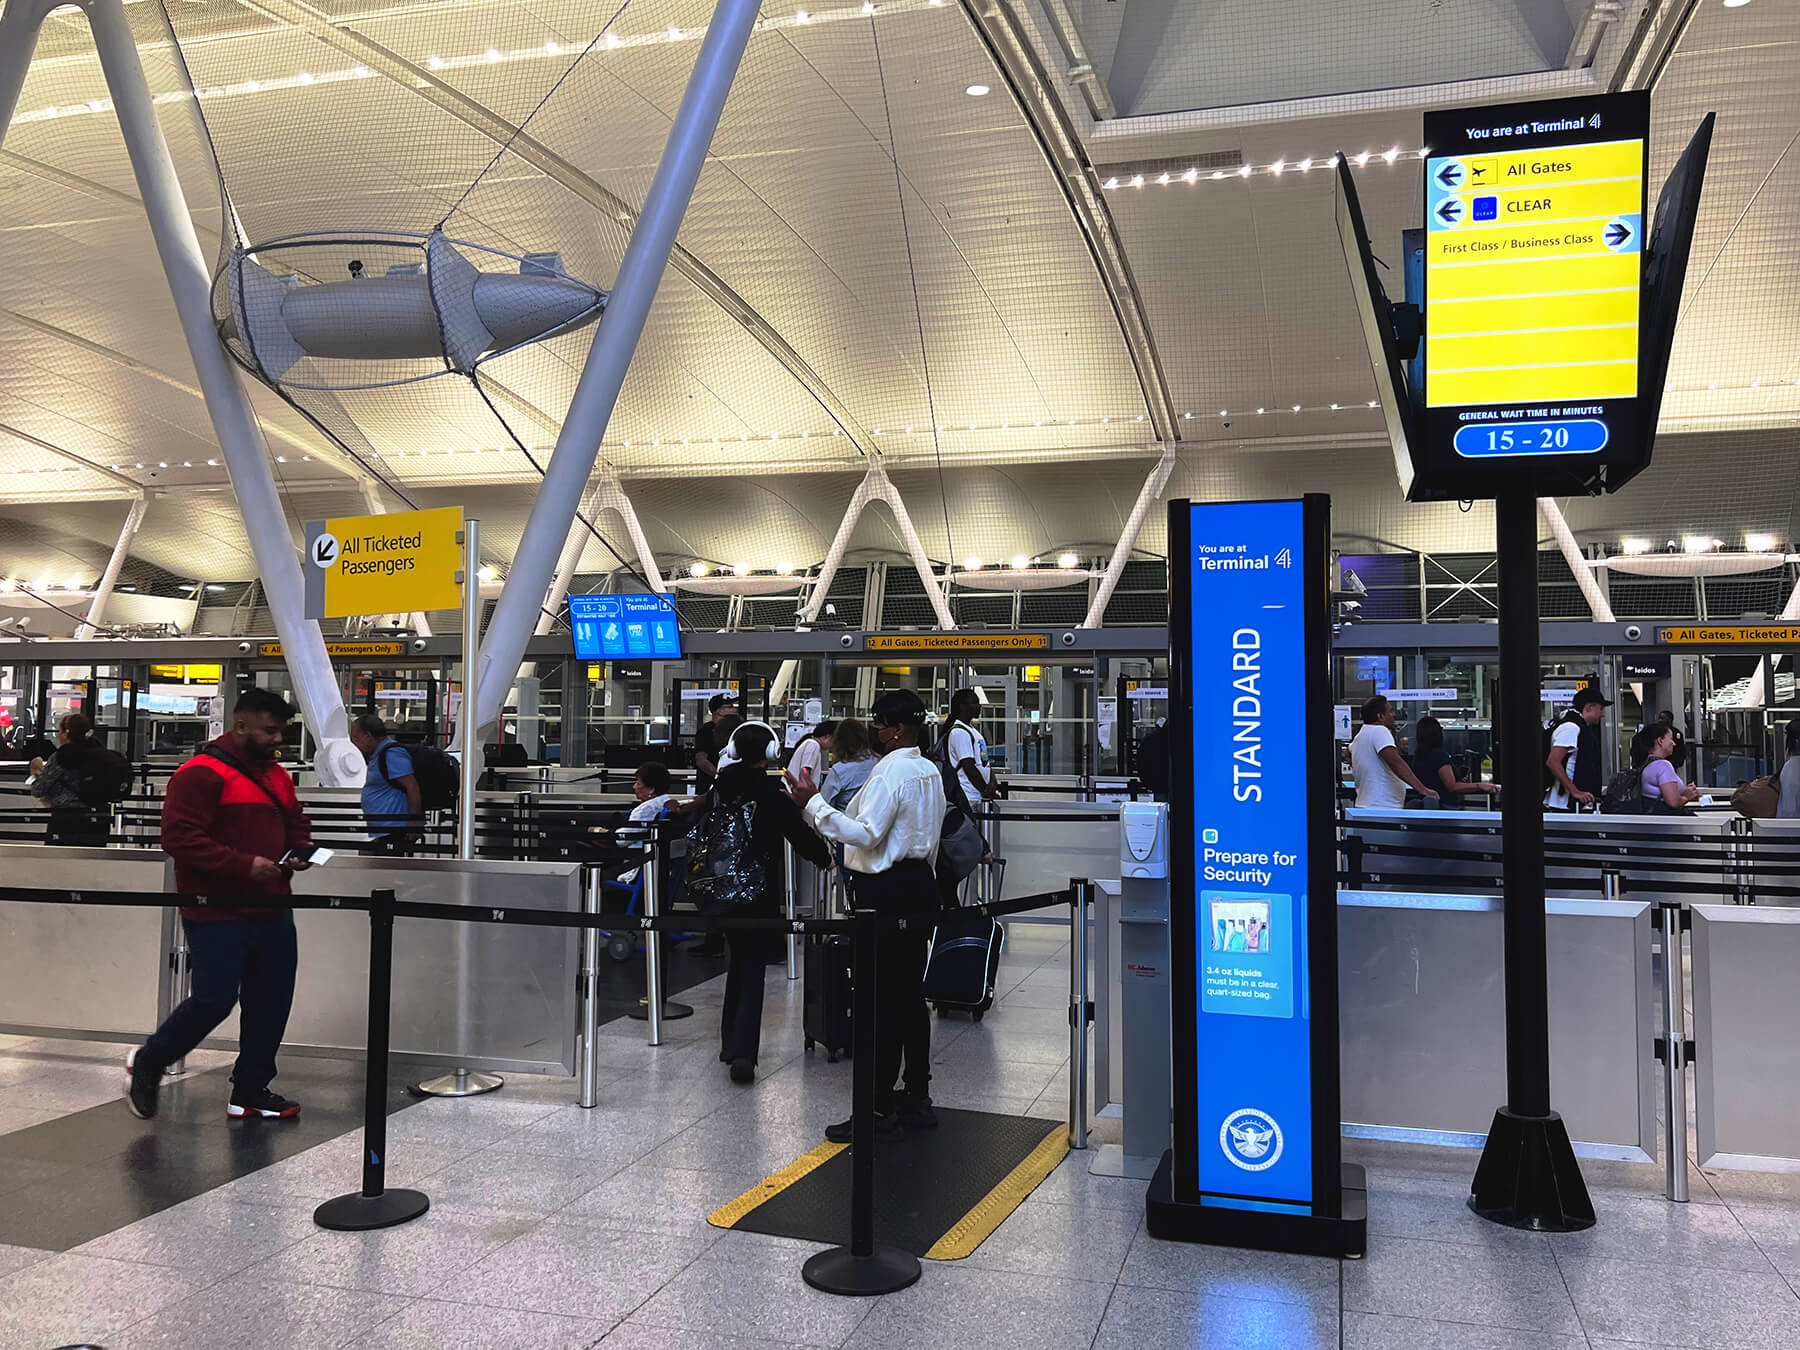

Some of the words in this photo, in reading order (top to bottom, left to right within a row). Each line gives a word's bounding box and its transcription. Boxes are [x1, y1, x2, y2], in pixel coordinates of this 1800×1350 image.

[1466, 128, 1490, 140] You
[1492, 127, 1512, 137] are
[1515, 124, 1529, 134] at
[1530, 116, 1585, 133] Terminal
[1588, 113, 1601, 129] 4
[1507, 163, 1526, 176] All
[1531, 162, 1572, 175] Gates
[1507, 199, 1552, 213] CLEAR
[1443, 244, 1467, 254] First
[1470, 241, 1499, 252] Class
[1511, 237, 1560, 248] Business
[1564, 234, 1593, 245] Class
[1458, 411, 1499, 421] GENERAL
[1501, 409, 1525, 419] WAIT
[1526, 408, 1548, 418] TIME
[1550, 408, 1560, 416] IN
[1562, 406, 1604, 415] MINUTES
[1487, 430, 1514, 451] 15
[1540, 427, 1569, 448] 20
[341, 537, 360, 555] All
[363, 531, 421, 553] Ticketed
[1198, 545, 1216, 553] You
[1198, 554, 1269, 570] Terminal
[1274, 547, 1292, 569] 4
[341, 557, 415, 576] Passengers
[583, 604, 592, 612] 15
[626, 603, 658, 611] Terminal
[1661, 631, 1673, 640] 10
[1680, 630, 1695, 640] All
[1699, 630, 1735, 641] Gates,
[1739, 629, 1787, 639] Ticketed
[335, 645, 373, 654] Passengers
[375, 645, 391, 653] Only
[881, 639, 892, 647] All
[894, 638, 921, 648] Gates,
[924, 638, 960, 647] Ticketed
[961, 638, 1009, 648] Passengers
[1011, 638, 1032, 648] Only
[1232, 628, 1262, 802] STANDARD
[1203, 848, 1269, 866] Prepare
[1272, 851, 1297, 866] for
[1203, 866, 1272, 886] Security
[1206, 966, 1219, 975] 3.4
[1233, 968, 1262, 977] liquids
[1229, 978, 1240, 986] be
[1241, 979, 1249, 987] in
[1207, 988, 1252, 998] quart-sized
